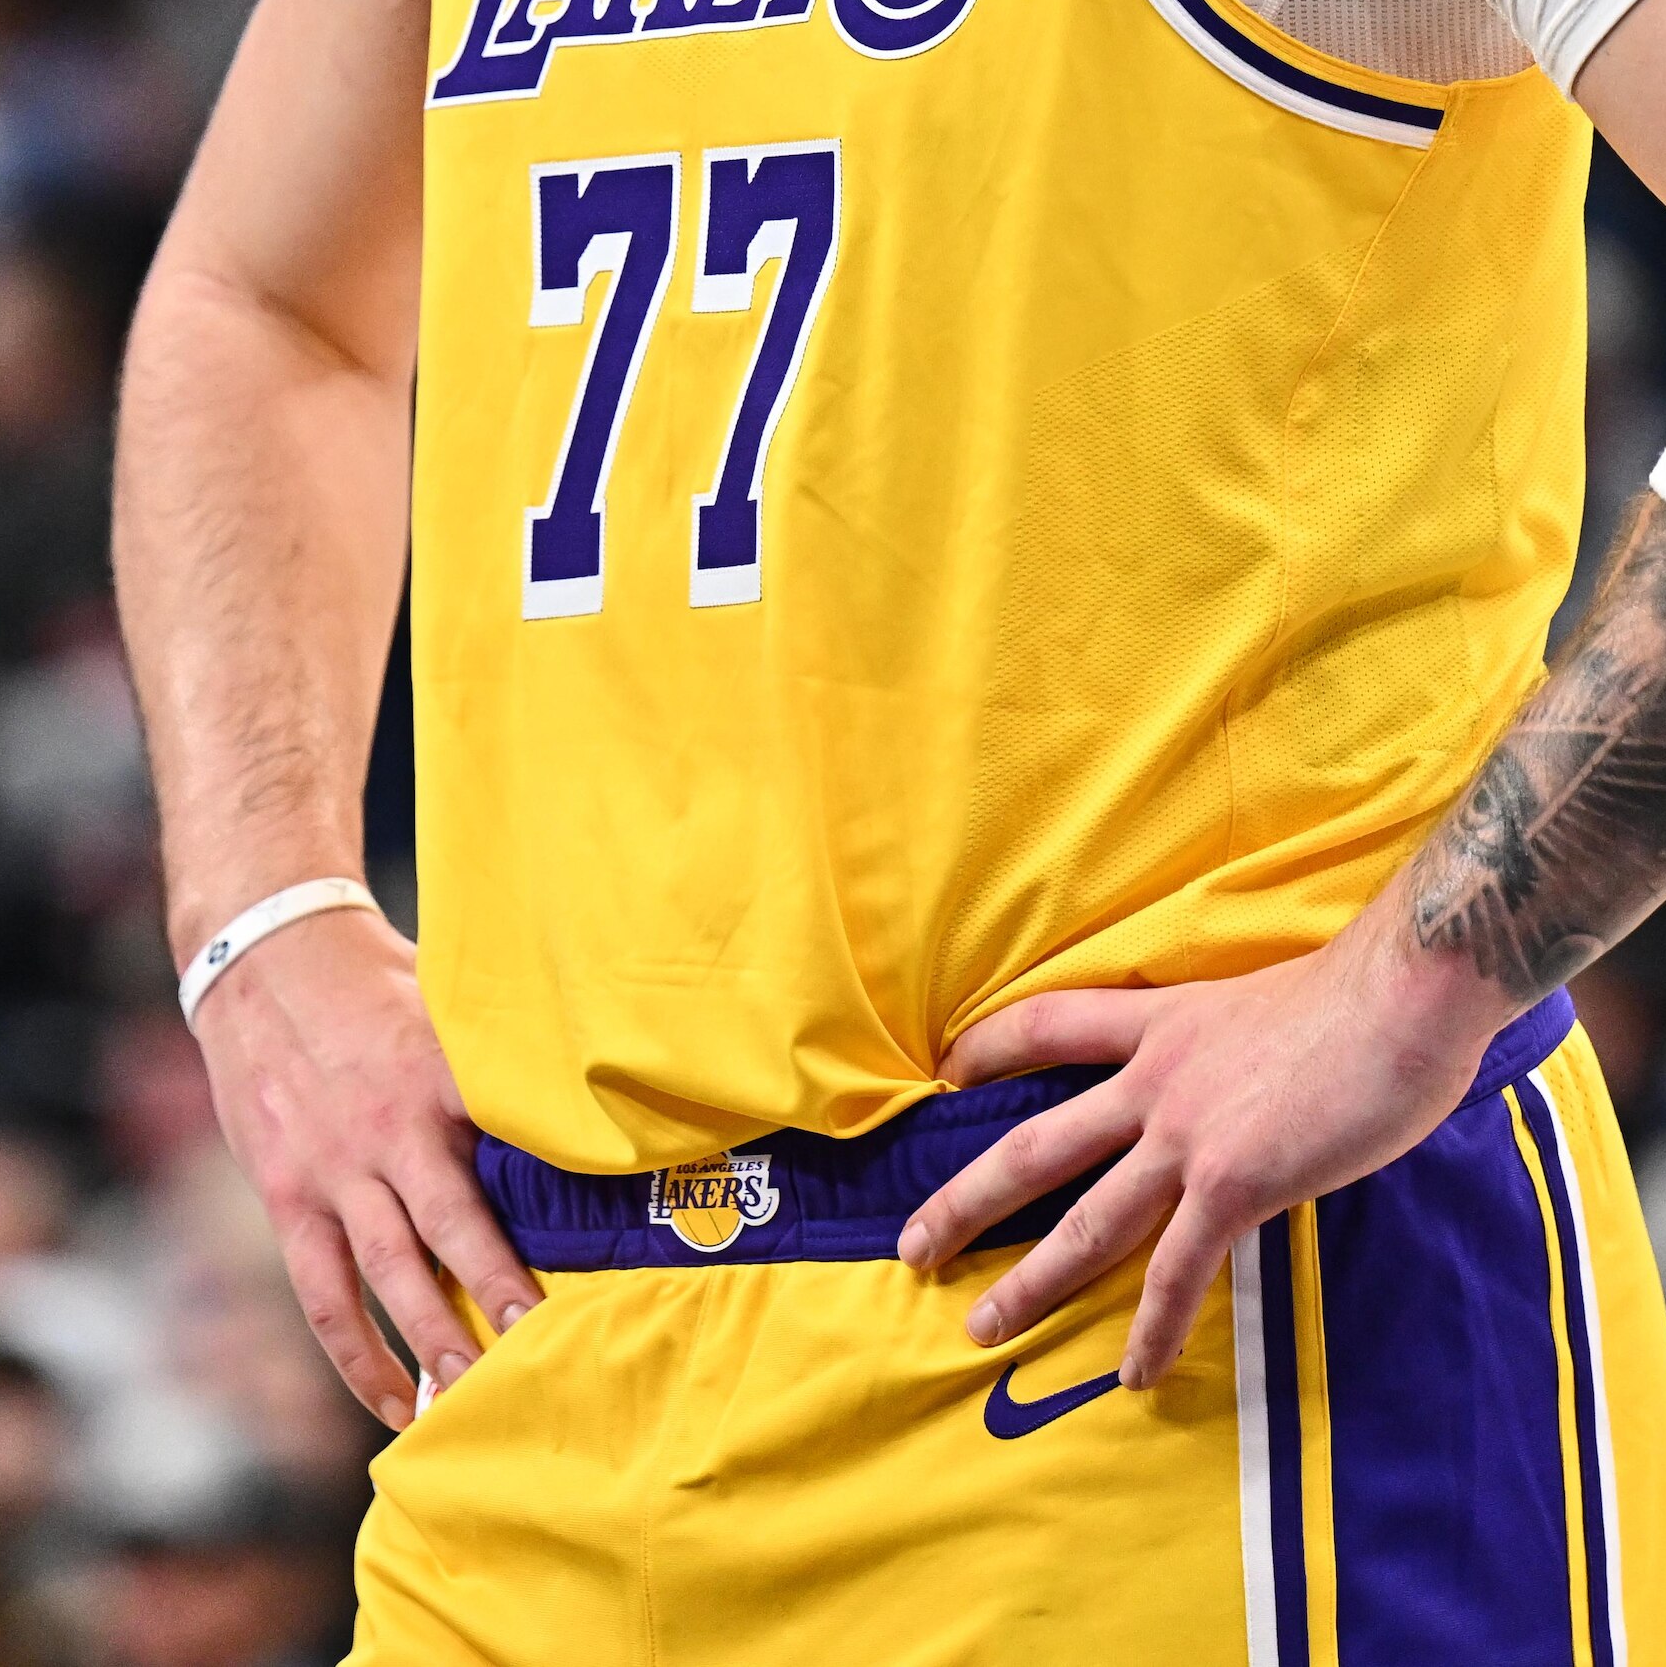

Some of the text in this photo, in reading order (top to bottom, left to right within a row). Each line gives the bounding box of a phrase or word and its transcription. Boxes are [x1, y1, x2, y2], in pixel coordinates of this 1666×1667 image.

[522, 138, 842, 621] 77
[650, 1167, 773, 1220] LAKERS
[676, 1161, 764, 1174] LOS ANGELES
